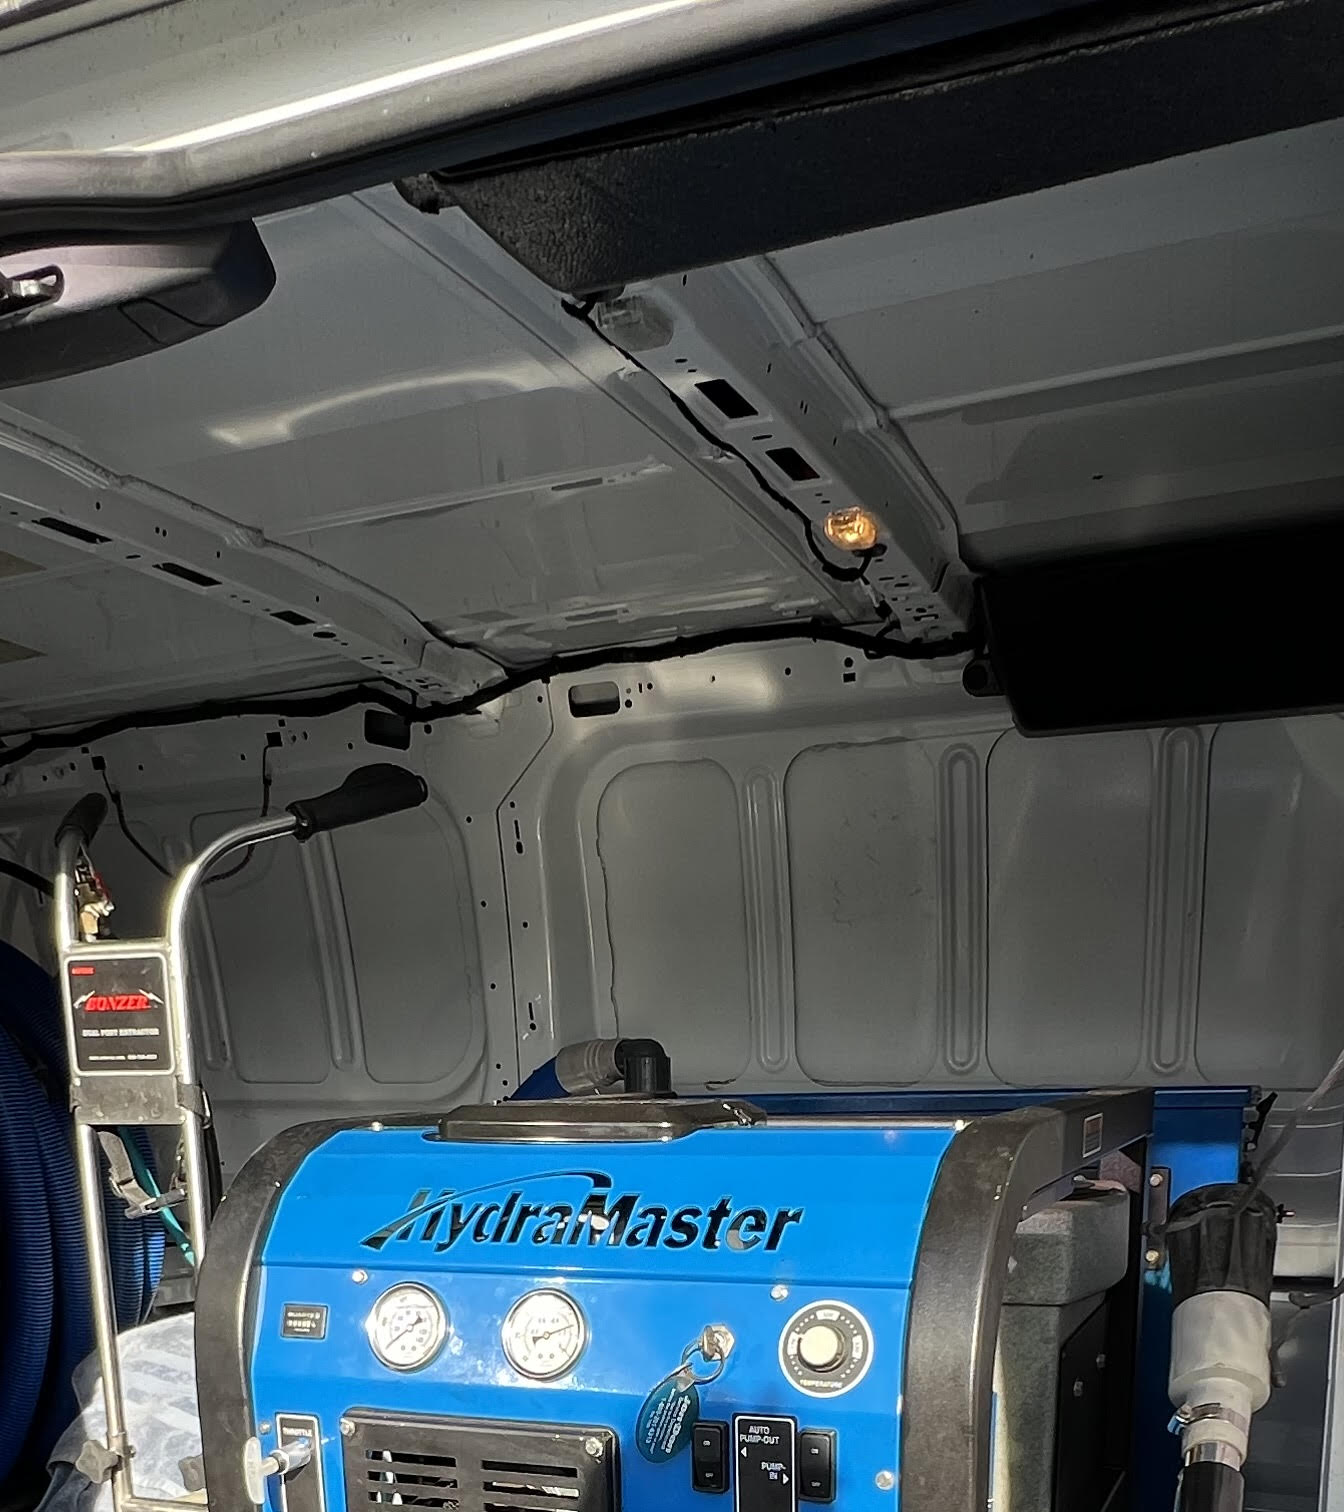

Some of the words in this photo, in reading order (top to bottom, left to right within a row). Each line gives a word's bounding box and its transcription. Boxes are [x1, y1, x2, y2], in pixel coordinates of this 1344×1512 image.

[84, 994, 151, 1011] BONZER
[394, 1187, 804, 1252] HydraMaster
[748, 1425, 770, 1434] AUTO
[739, 1434, 780, 1445] PUMP-OUT
